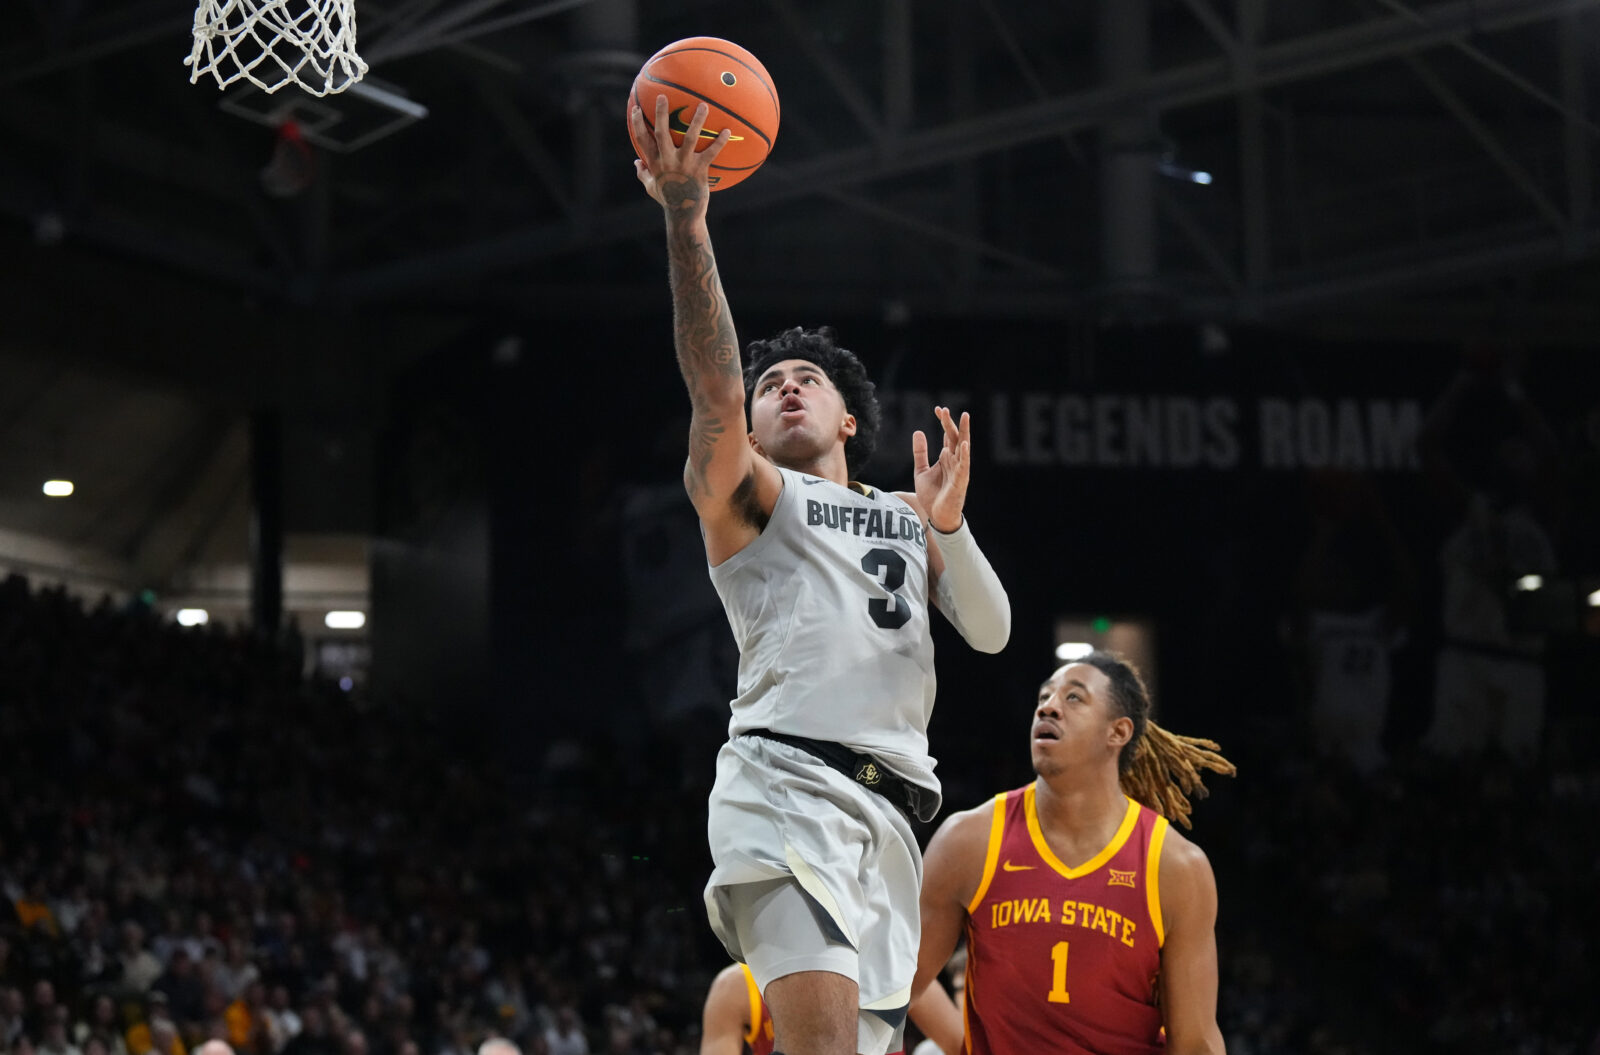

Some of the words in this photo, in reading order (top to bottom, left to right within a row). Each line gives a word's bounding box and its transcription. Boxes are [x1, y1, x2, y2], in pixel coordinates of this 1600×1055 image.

[991, 395, 1240, 470] LEGENDS
[1259, 399, 1423, 472] ROAM
[861, 548, 912, 629] 3
[992, 898, 1051, 929] IOWA
[1060, 900, 1137, 948] STATE
[1047, 941, 1070, 1004] 1
